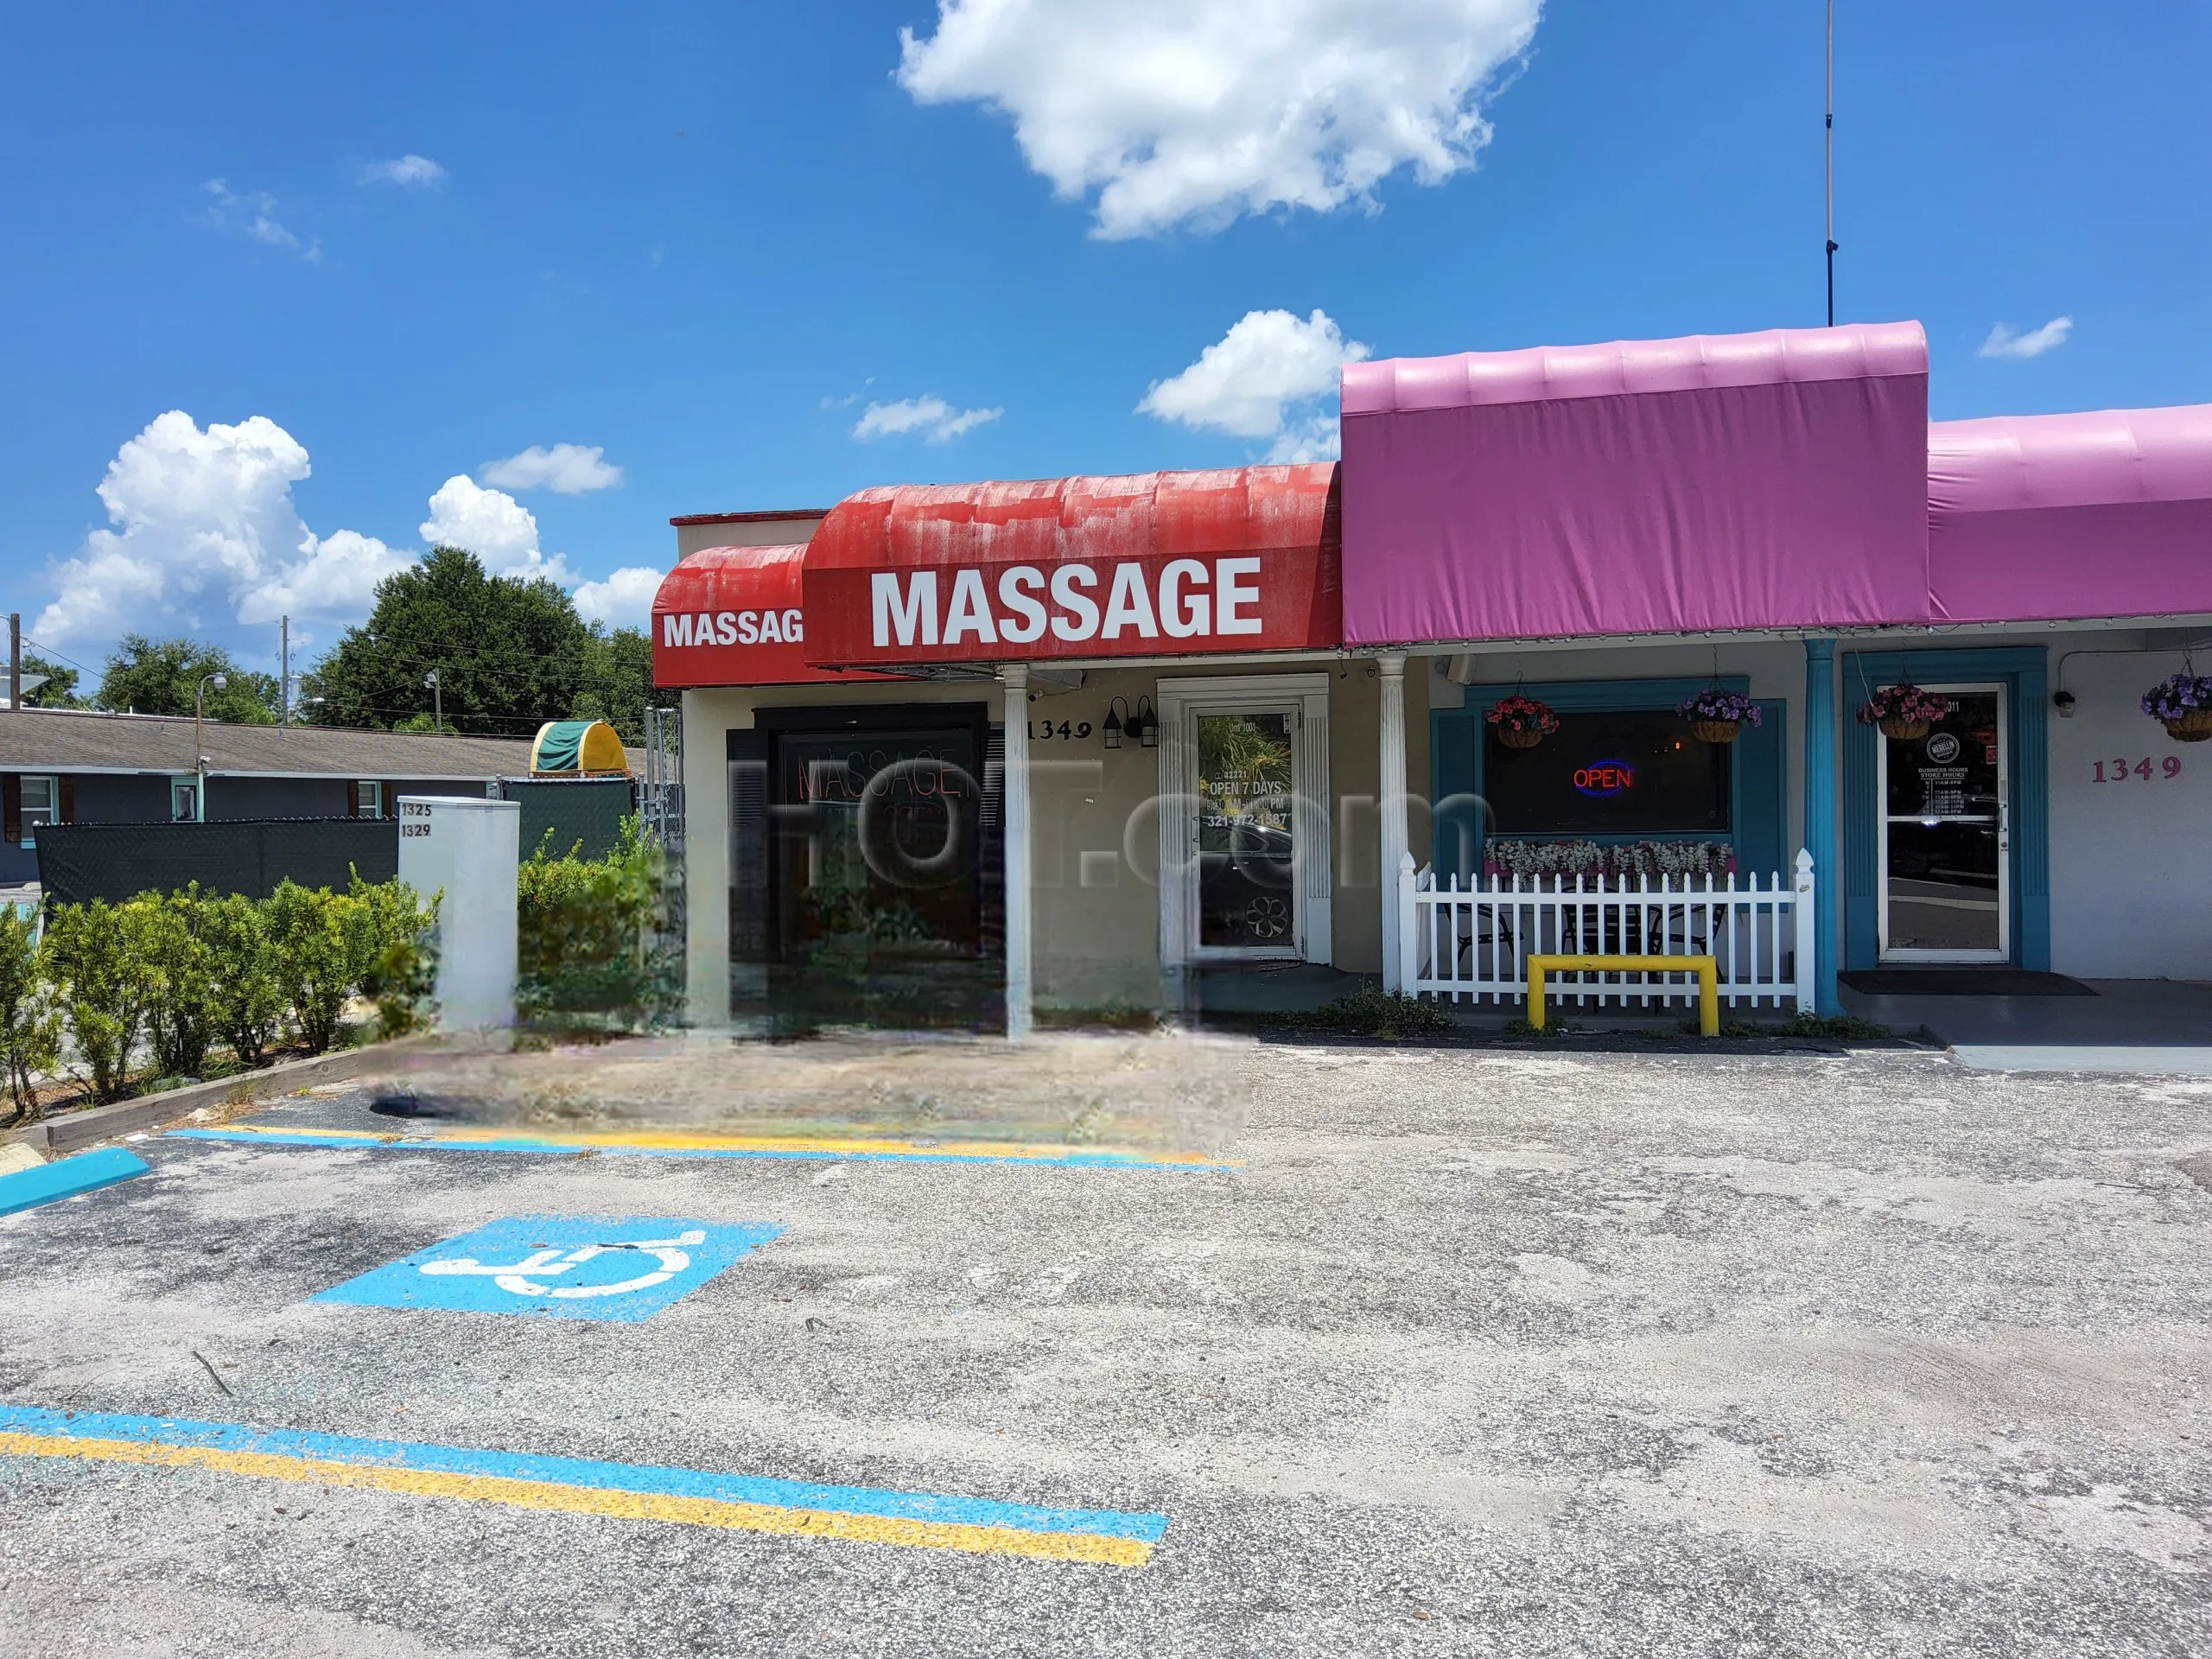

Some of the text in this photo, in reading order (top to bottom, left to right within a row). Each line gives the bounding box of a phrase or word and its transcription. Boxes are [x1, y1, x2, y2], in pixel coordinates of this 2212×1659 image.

[871, 556, 1263, 648] MASSAGE
[663, 608, 804, 648] MASSAG
[1027, 719, 1092, 741] 1349
[798, 748, 961, 800] MASSAGE
[1573, 769, 1632, 788] OPEN
[2092, 756, 2182, 783] 1349
[1210, 780, 1282, 796] OPEN 7 DAYS
[402, 804, 432, 817] 1325
[1207, 799, 1225, 810] 9:30
[1270, 798, 1284, 810] PM
[1207, 812, 1287, 828] 321-972-1587
[402, 823, 431, 837] 1329
